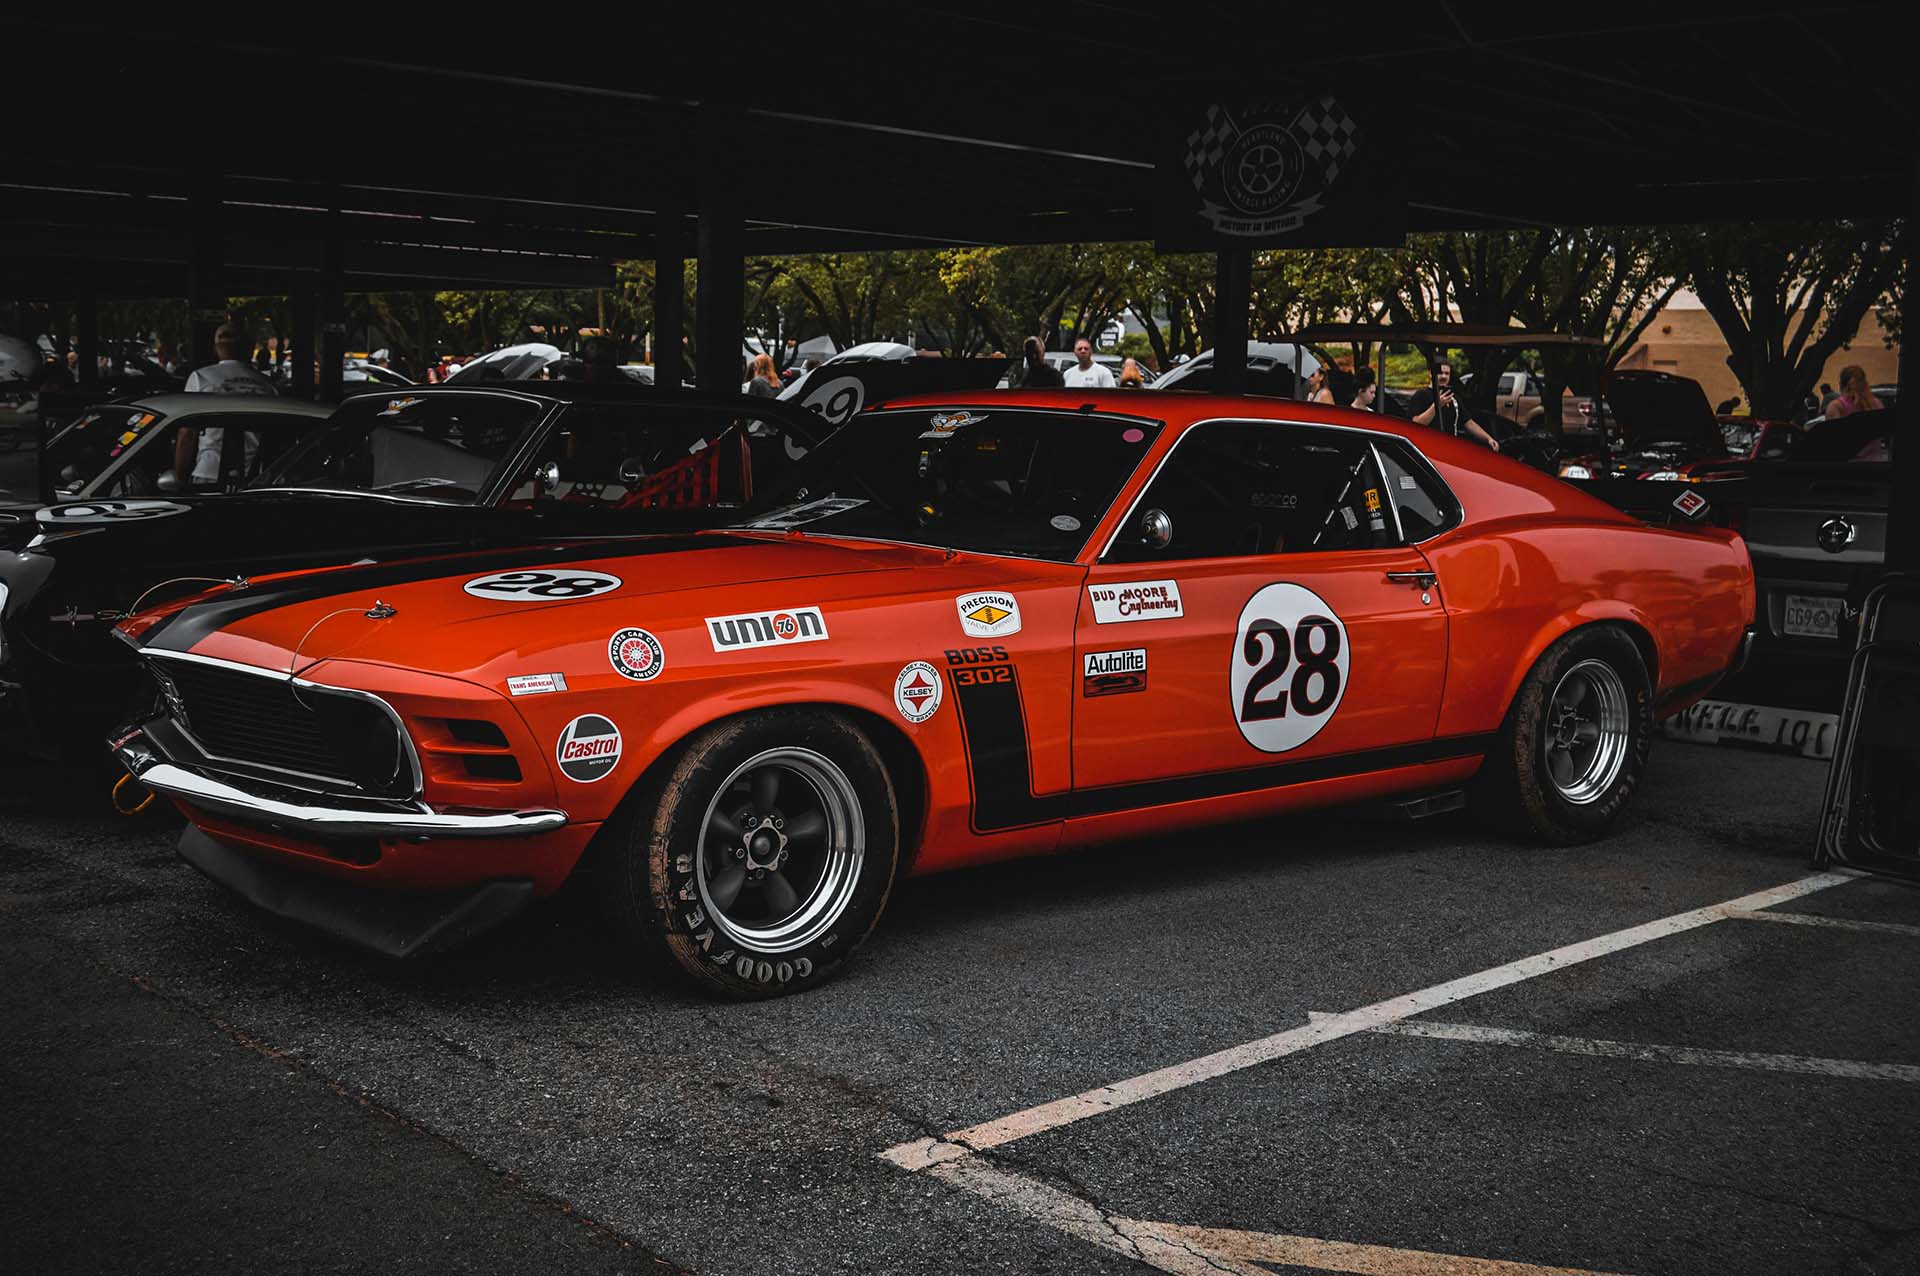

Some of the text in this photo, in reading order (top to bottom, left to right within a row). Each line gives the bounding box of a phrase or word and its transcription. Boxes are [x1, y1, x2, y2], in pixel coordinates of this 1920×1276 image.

[468, 572, 615, 596] 28
[1092, 587, 1168, 602] BUD MOORE
[960, 596, 1014, 613] PRECISION
[1118, 593, 1178, 616] Engineering
[777, 618, 796, 634] 76
[612, 633, 627, 661] SPORTS
[645, 637, 660, 655] CLUB
[944, 646, 1010, 665] BOSS
[620, 661, 660, 678] OF AMERICA
[898, 662, 938, 681] KELSEY HAYES
[1087, 651, 1144, 675] Autolite
[1240, 615, 1341, 723] 28
[527, 680, 554, 688] AMERICAN
[956, 667, 1011, 686] 302
[903, 688, 933, 697] KELSEY
[563, 736, 619, 760] Castrol
